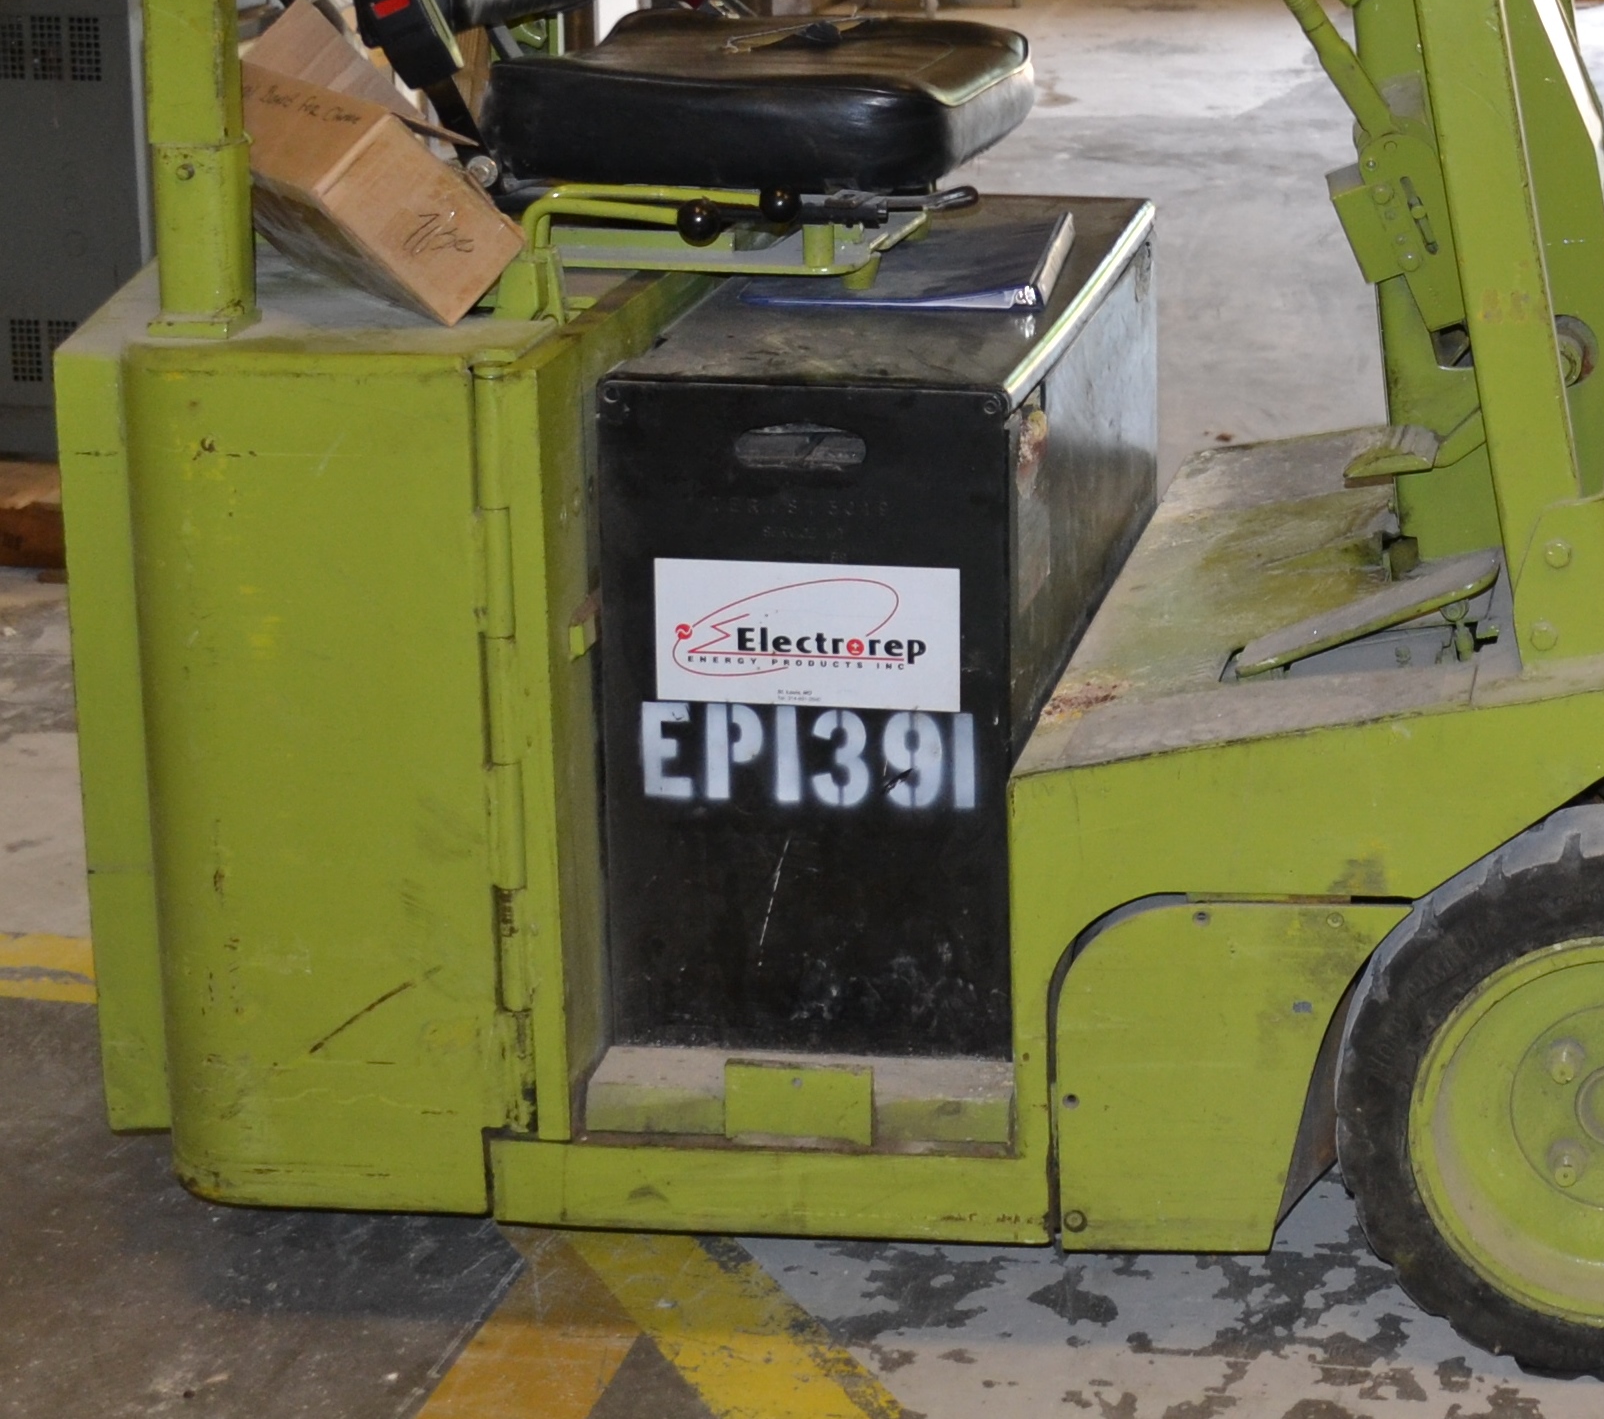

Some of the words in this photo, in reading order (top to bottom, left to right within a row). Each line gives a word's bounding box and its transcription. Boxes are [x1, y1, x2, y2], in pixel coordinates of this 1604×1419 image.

[737, 626, 927, 665] Electrorep
[688, 655, 758, 667] ENERGY
[771, 658, 864, 670] PRODUCTS
[876, 662, 906, 671] INC
